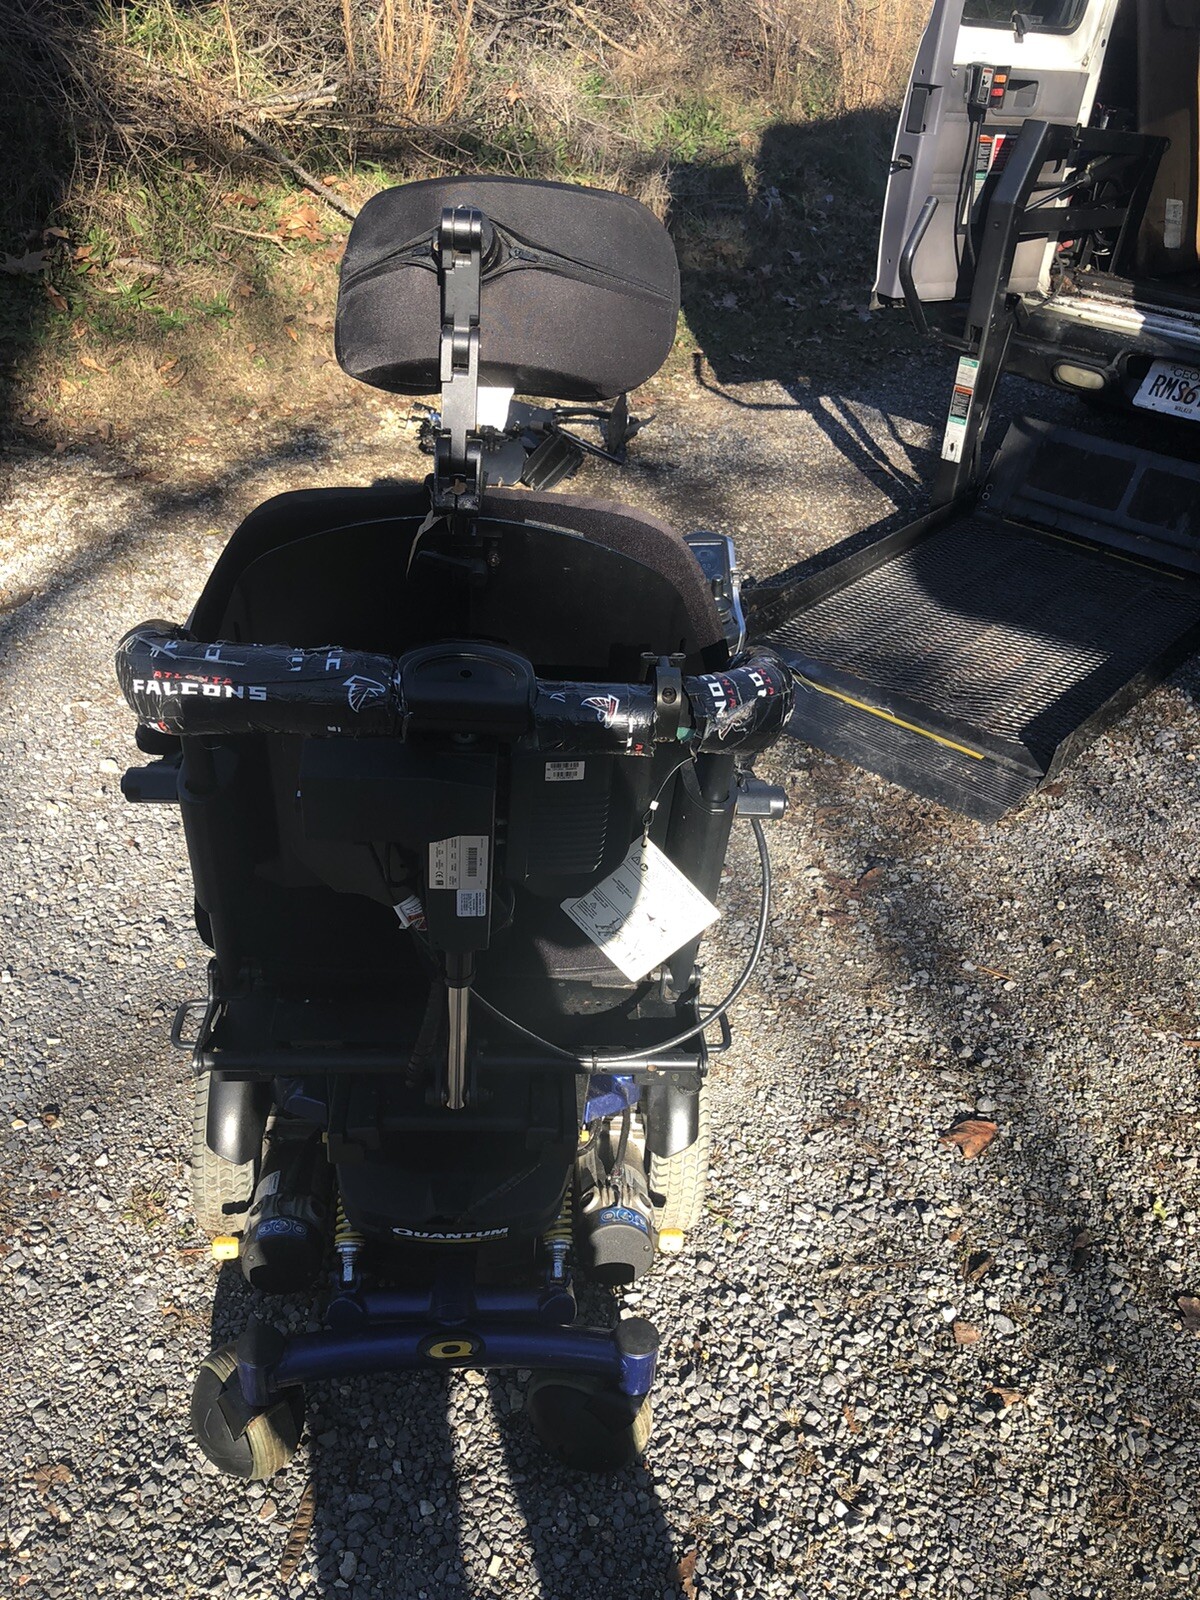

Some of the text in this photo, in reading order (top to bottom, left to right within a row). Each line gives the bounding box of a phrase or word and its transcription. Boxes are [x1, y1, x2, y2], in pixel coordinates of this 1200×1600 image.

[1173, 367, 1200, 382] GEO
[1148, 374, 1200, 407] RMS6
[153, 670, 232, 685] ATLANTA
[132, 679, 267, 701] FALCONS
[391, 1226, 509, 1240] QUANTUM
